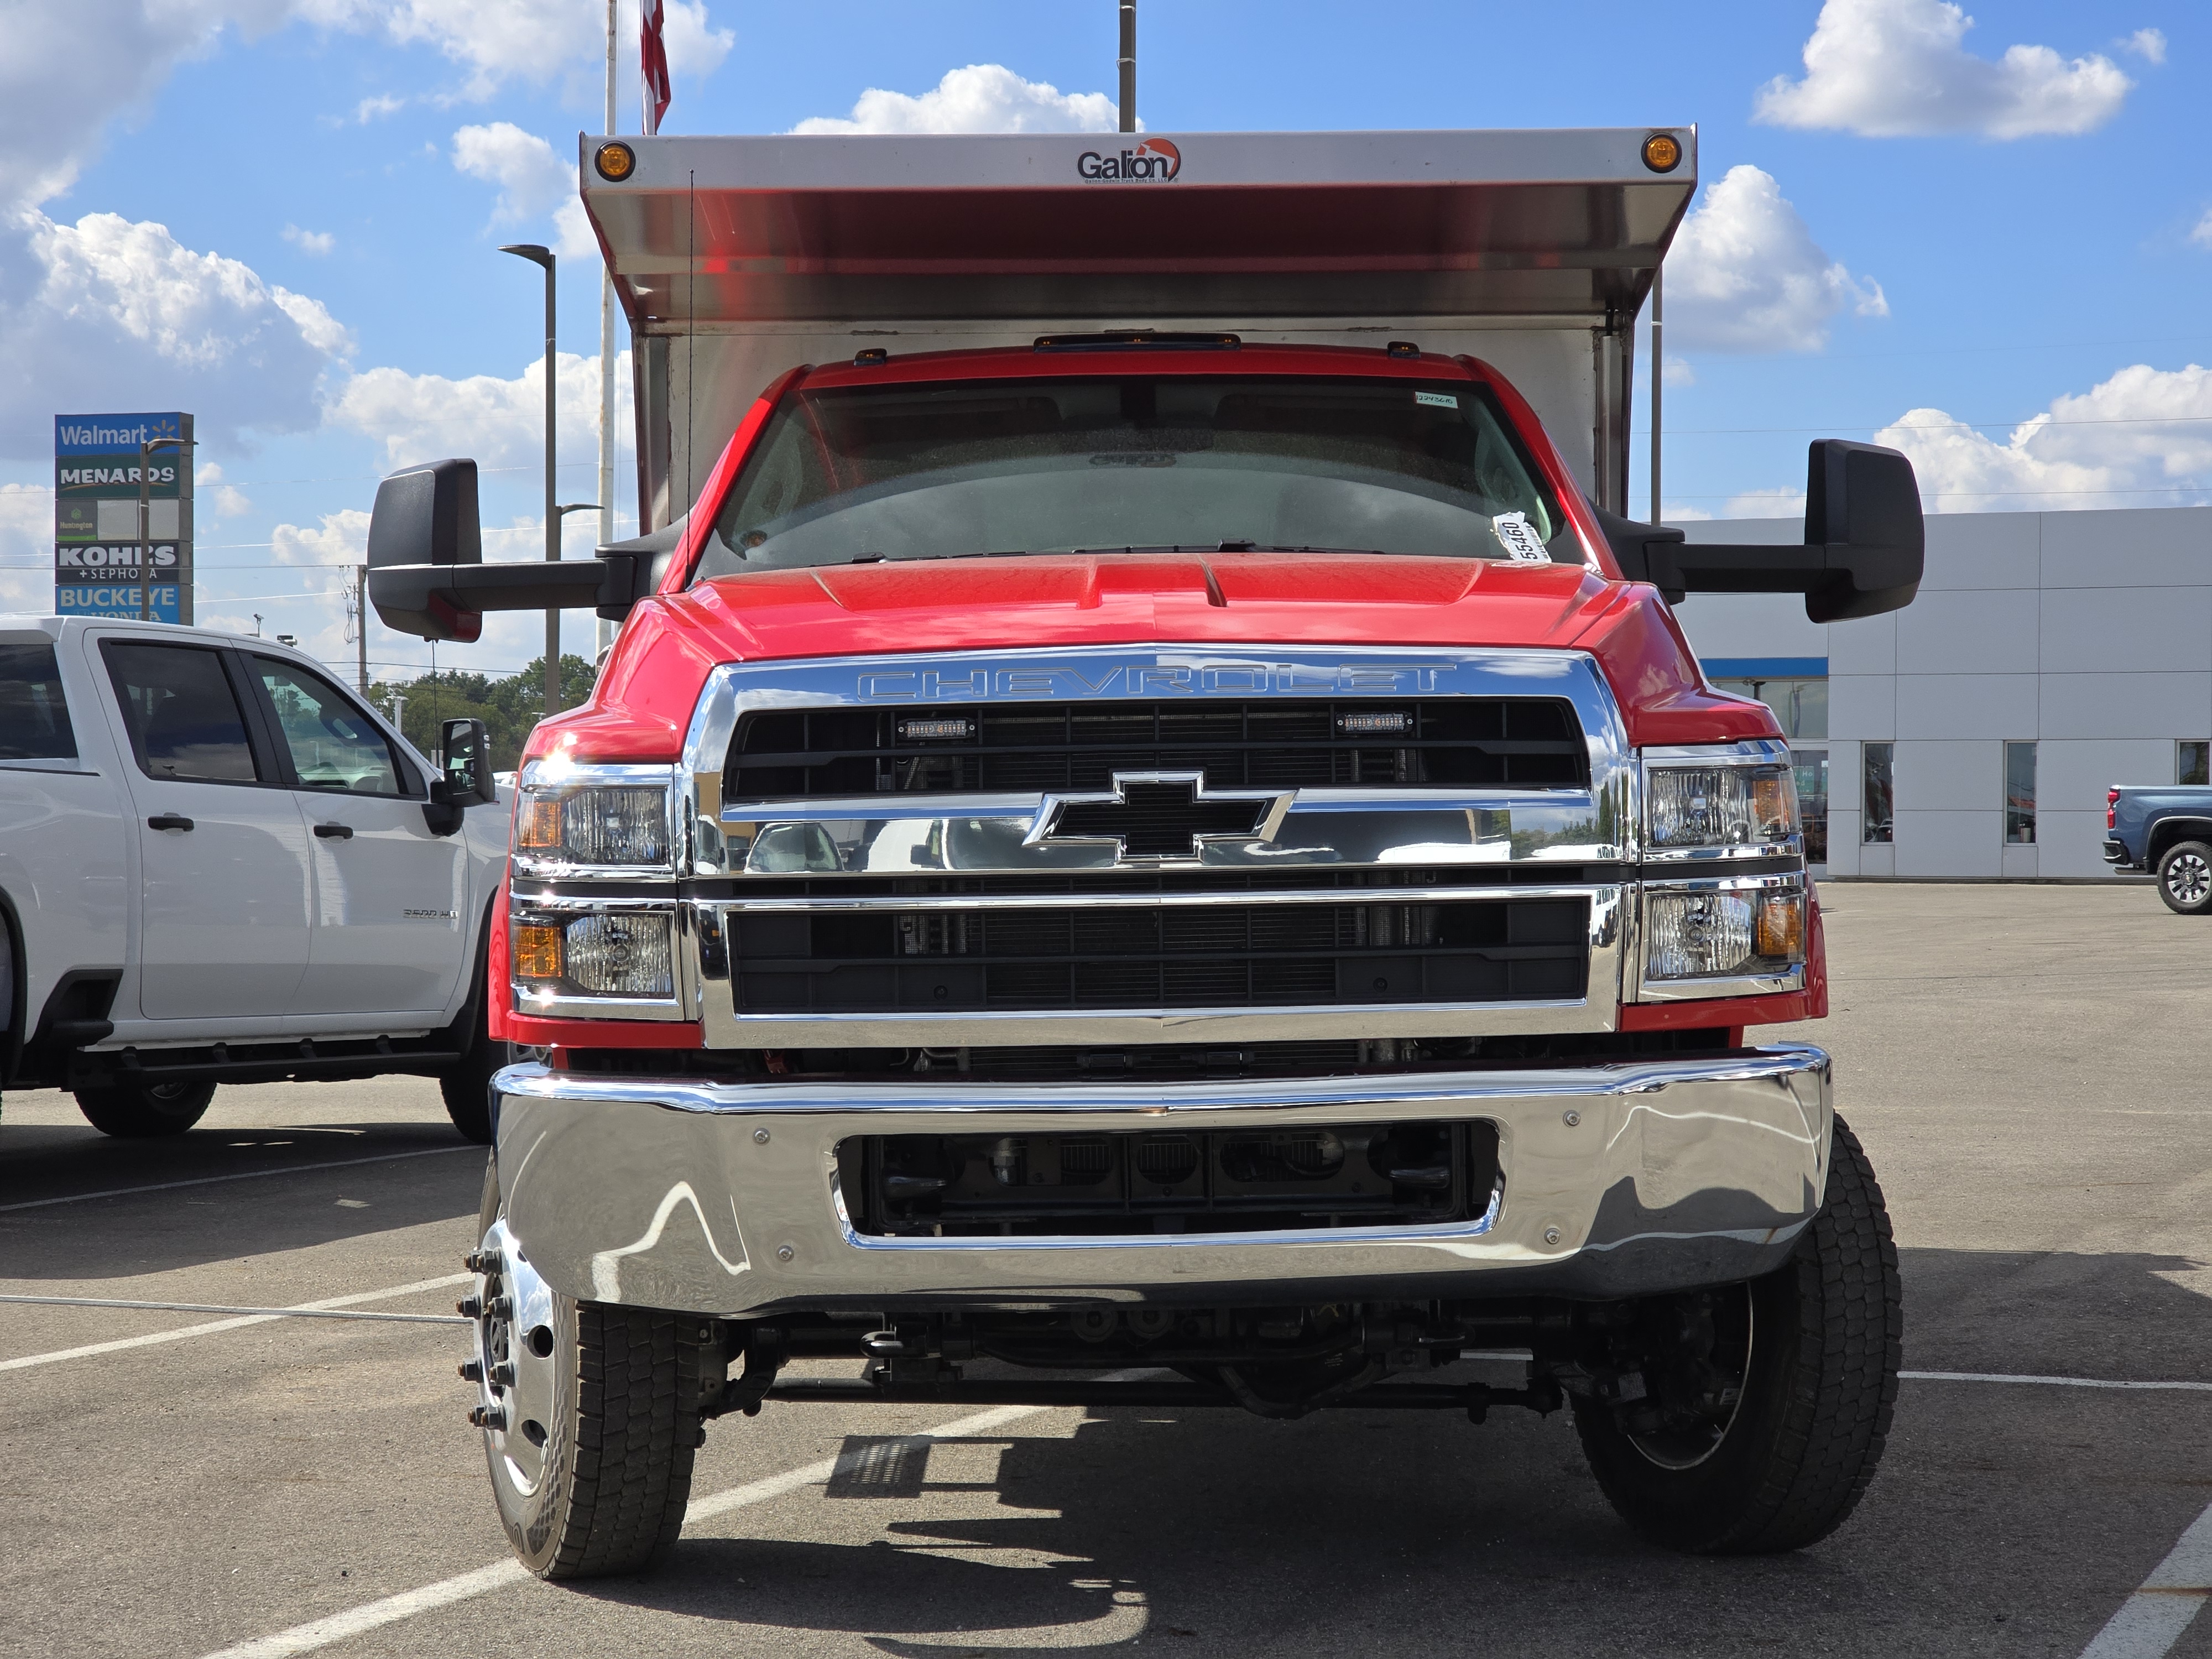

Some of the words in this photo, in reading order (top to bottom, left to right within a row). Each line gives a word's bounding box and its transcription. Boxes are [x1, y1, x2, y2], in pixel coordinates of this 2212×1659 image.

[1077, 150, 1168, 179] Galion
[60, 424, 147, 446] Walmart
[60, 467, 175, 484] MENARDS
[1501, 522, 1538, 560] 55460
[91, 568, 157, 579] SEPHOA
[60, 588, 175, 607] BUCKEYE
[857, 664, 1457, 702] CHEVROLET
